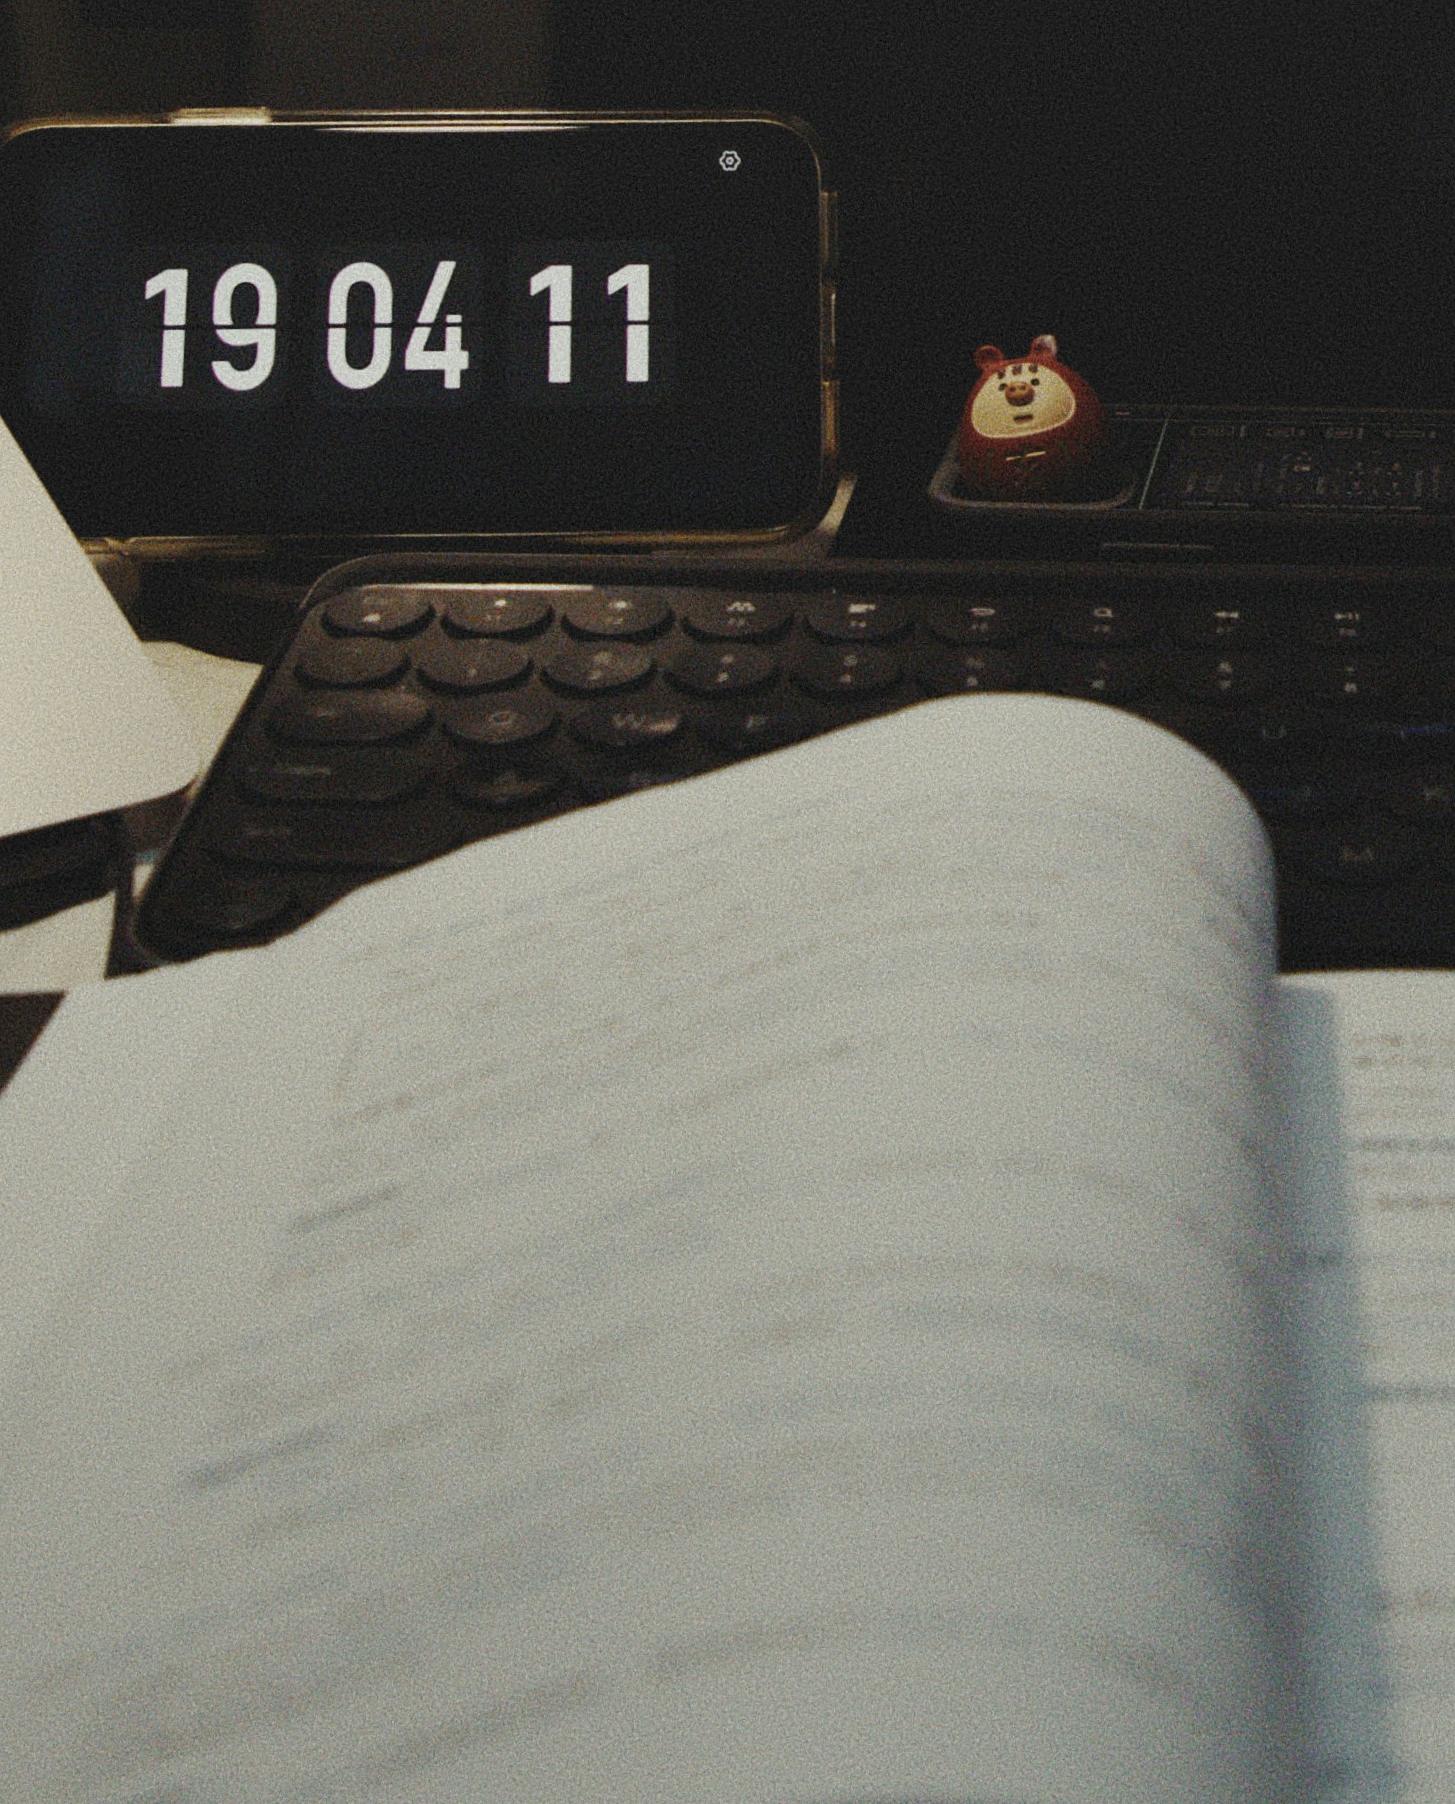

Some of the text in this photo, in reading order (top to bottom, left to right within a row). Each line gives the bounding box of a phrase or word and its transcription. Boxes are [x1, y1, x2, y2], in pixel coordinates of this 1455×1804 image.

[145, 259, 651, 391] 19 04 11
